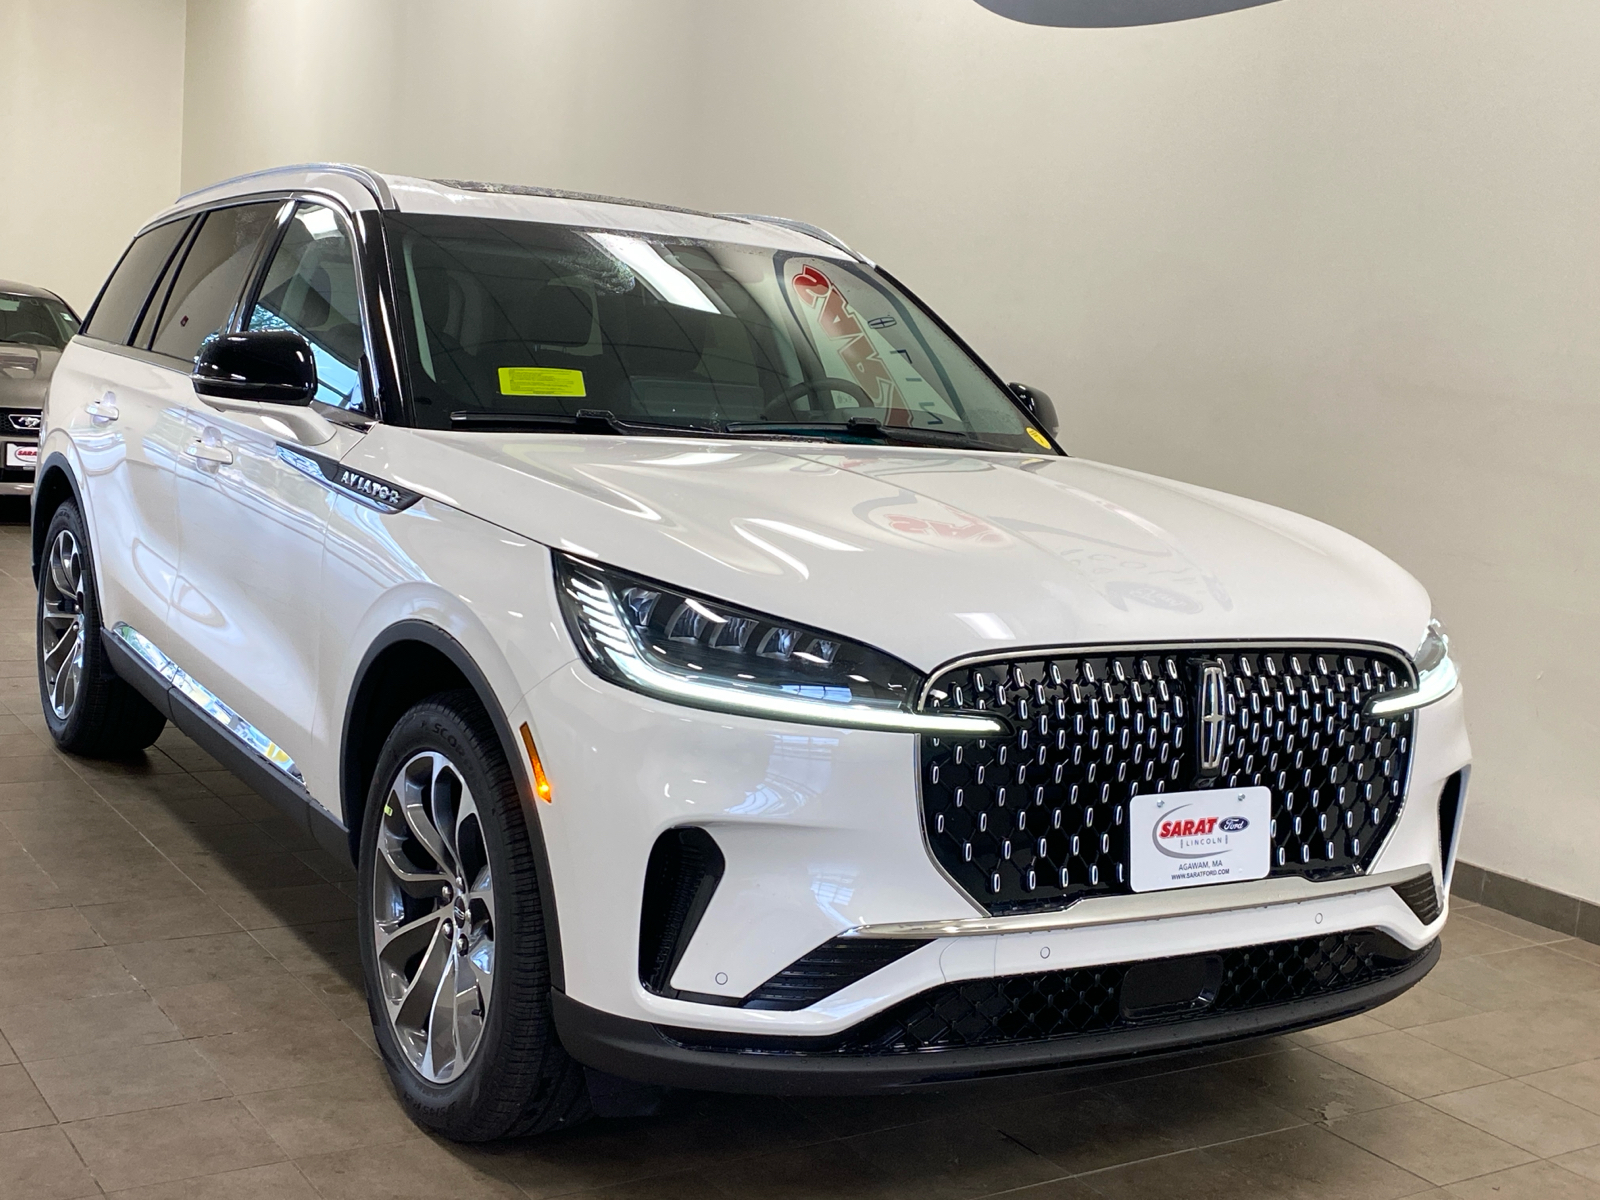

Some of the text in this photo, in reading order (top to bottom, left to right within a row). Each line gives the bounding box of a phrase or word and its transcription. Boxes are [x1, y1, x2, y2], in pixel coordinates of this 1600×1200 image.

[341, 471, 400, 504] AVIATOR
[1160, 817, 1246, 838] SARAT Ford
[1186, 837, 1222, 846] LINCOLN
[1178, 860, 1223, 871] AGAWAM, MA
[1171, 868, 1229, 880] WWW.SARATFORD.COM
